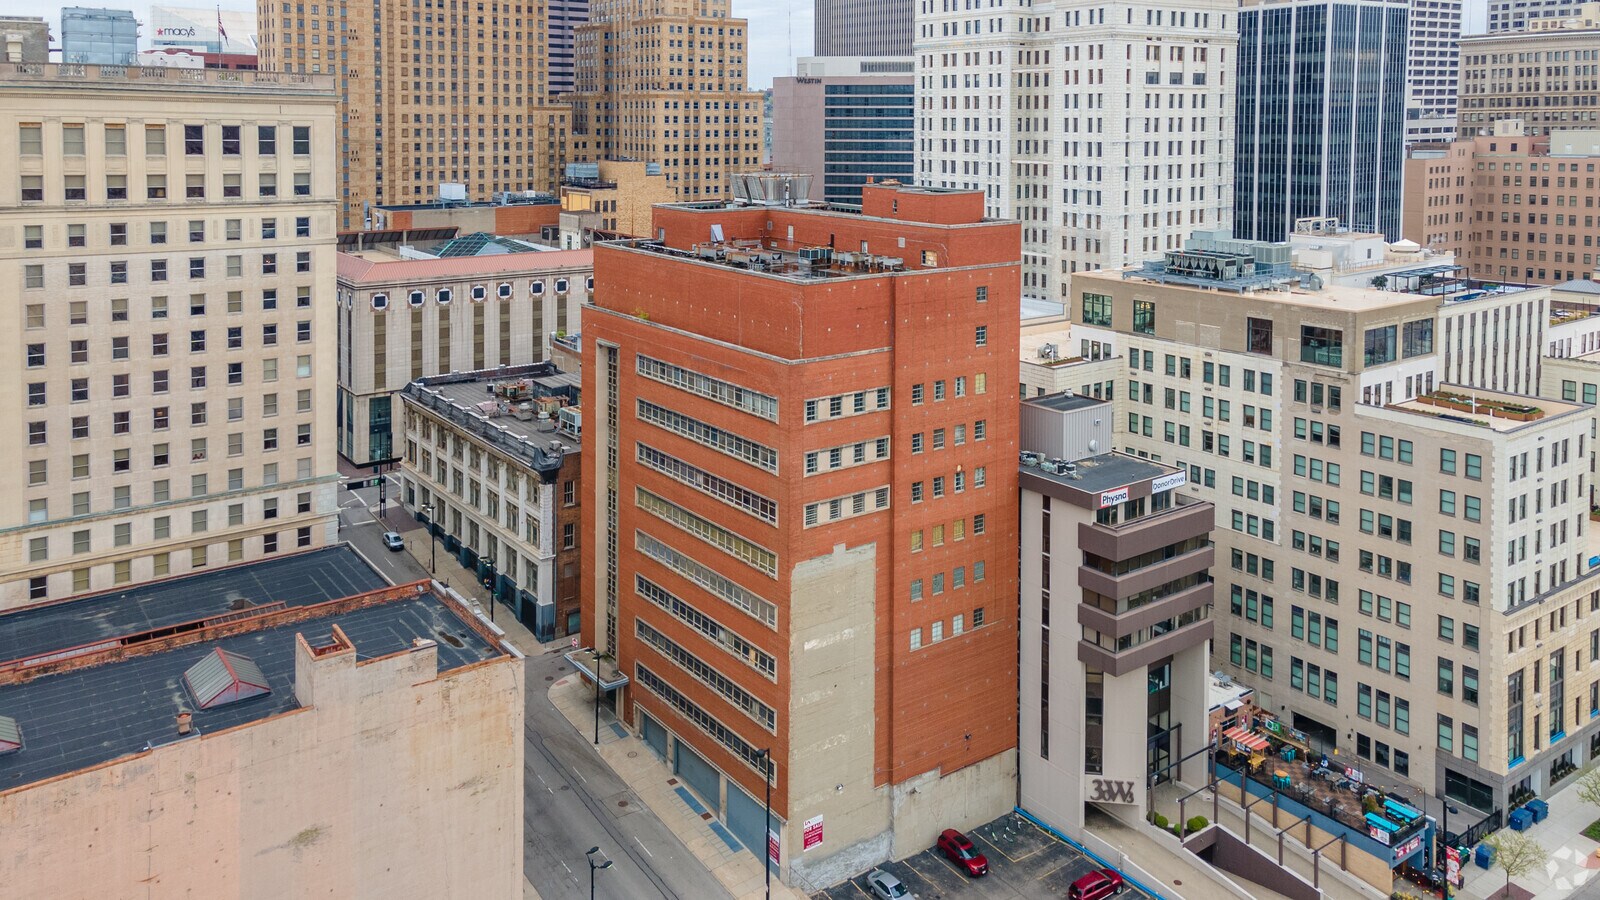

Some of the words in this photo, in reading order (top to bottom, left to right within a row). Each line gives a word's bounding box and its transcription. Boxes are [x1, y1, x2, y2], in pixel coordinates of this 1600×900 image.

[164, 26, 196, 38] macy's
[796, 76, 822, 84] WESTIN
[1152, 476, 1185, 490] DonorDrive
[1102, 492, 1127, 505] Physna
